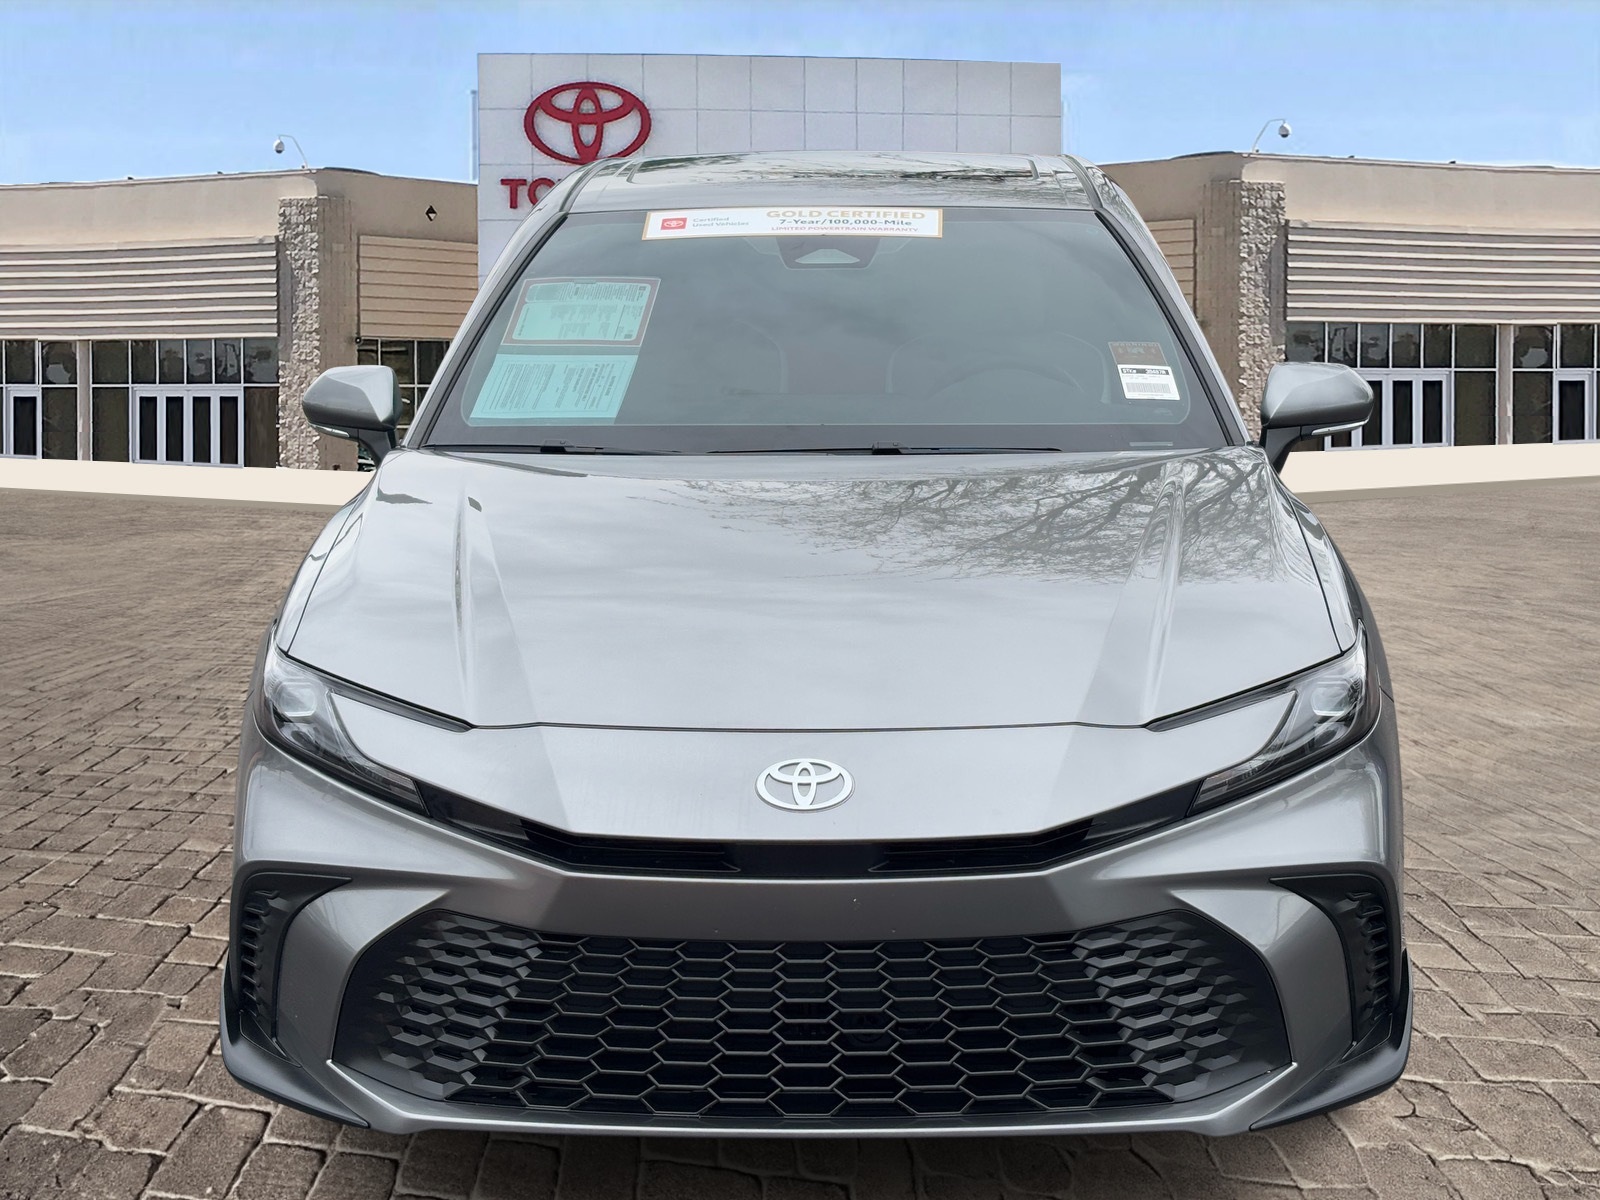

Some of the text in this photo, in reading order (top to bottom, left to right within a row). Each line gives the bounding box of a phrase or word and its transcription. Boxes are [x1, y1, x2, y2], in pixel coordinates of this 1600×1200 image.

[500, 177, 562, 210] TO
[766, 210, 926, 219] GOLD CERTIFIED
[779, 218, 913, 226] 7-Year/100,000-Mile
